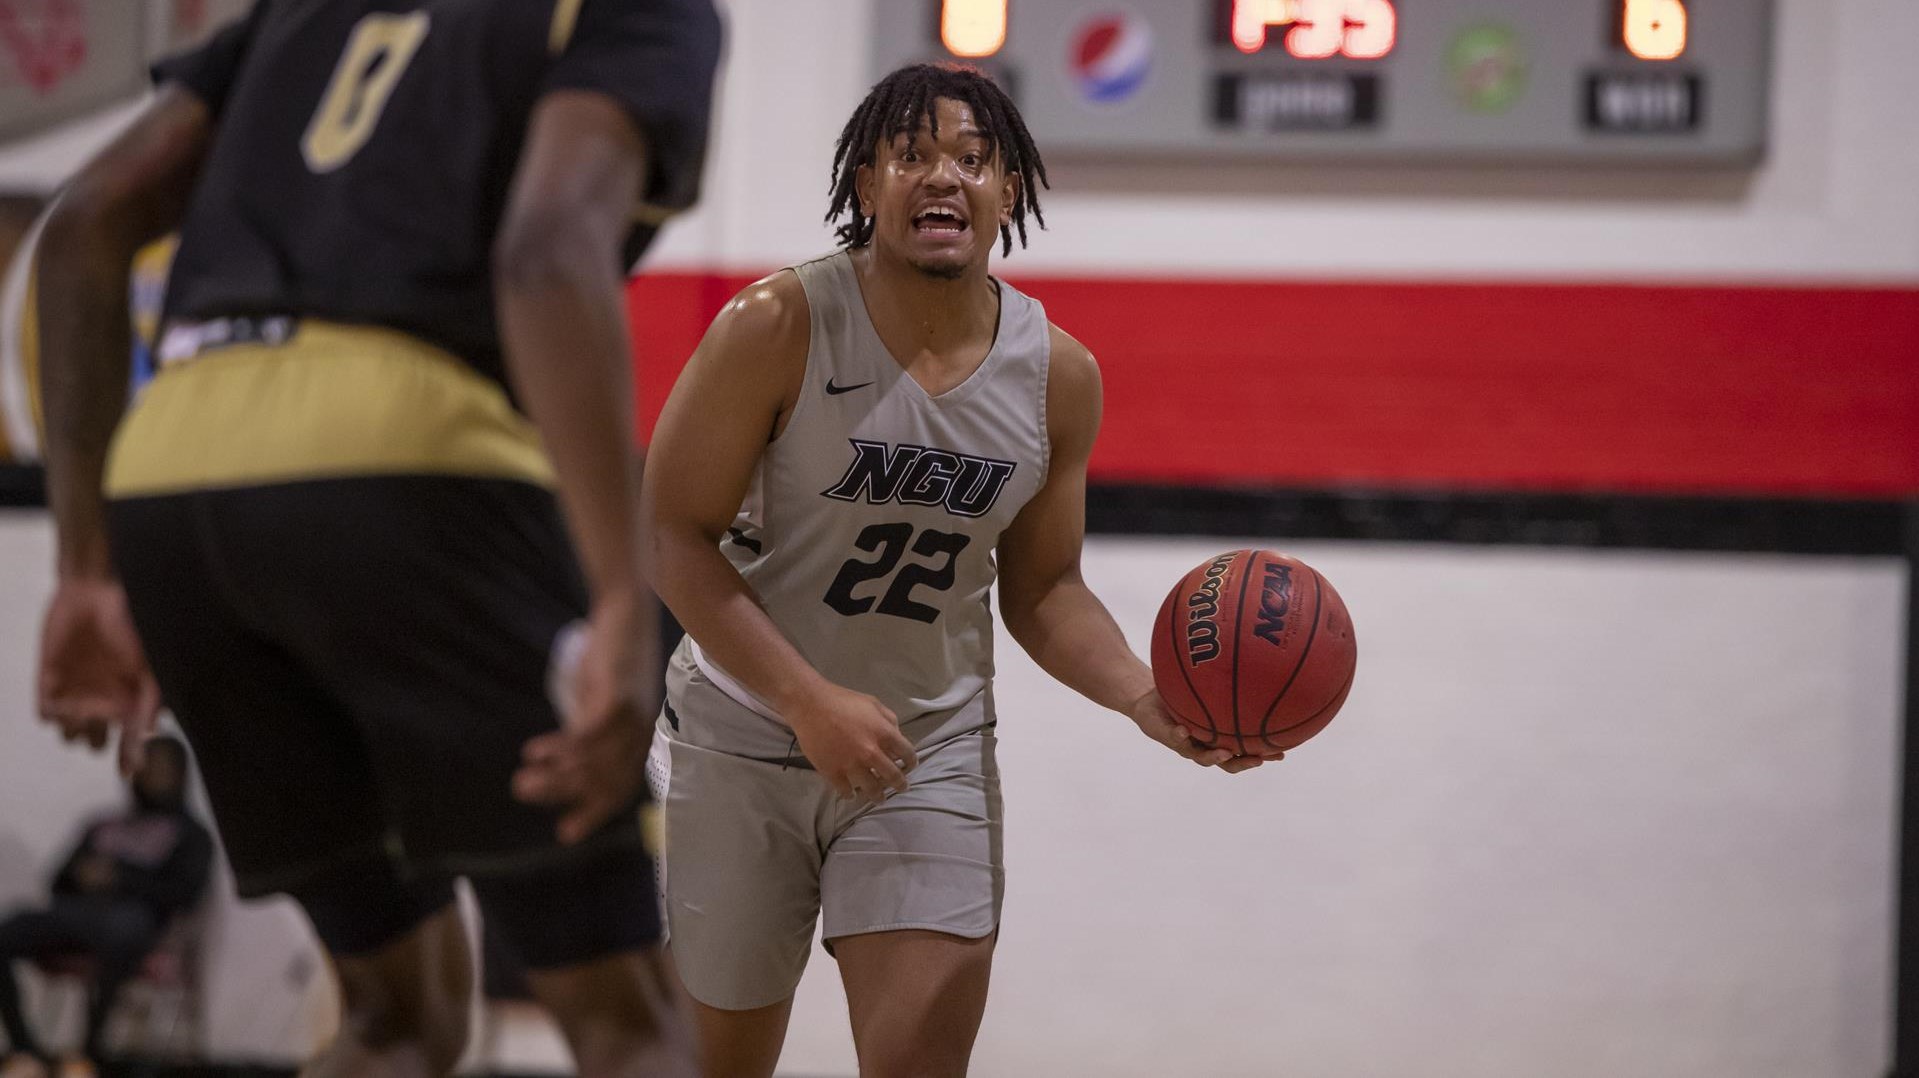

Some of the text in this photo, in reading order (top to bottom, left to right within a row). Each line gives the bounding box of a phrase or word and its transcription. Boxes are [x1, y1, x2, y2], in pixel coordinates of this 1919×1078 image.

[304, 12, 430, 173] 0
[819, 438, 1017, 518] NGU
[822, 521, 971, 624] 22
[1186, 551, 1240, 669] Wilson
[1252, 562, 1294, 647] NCAA
